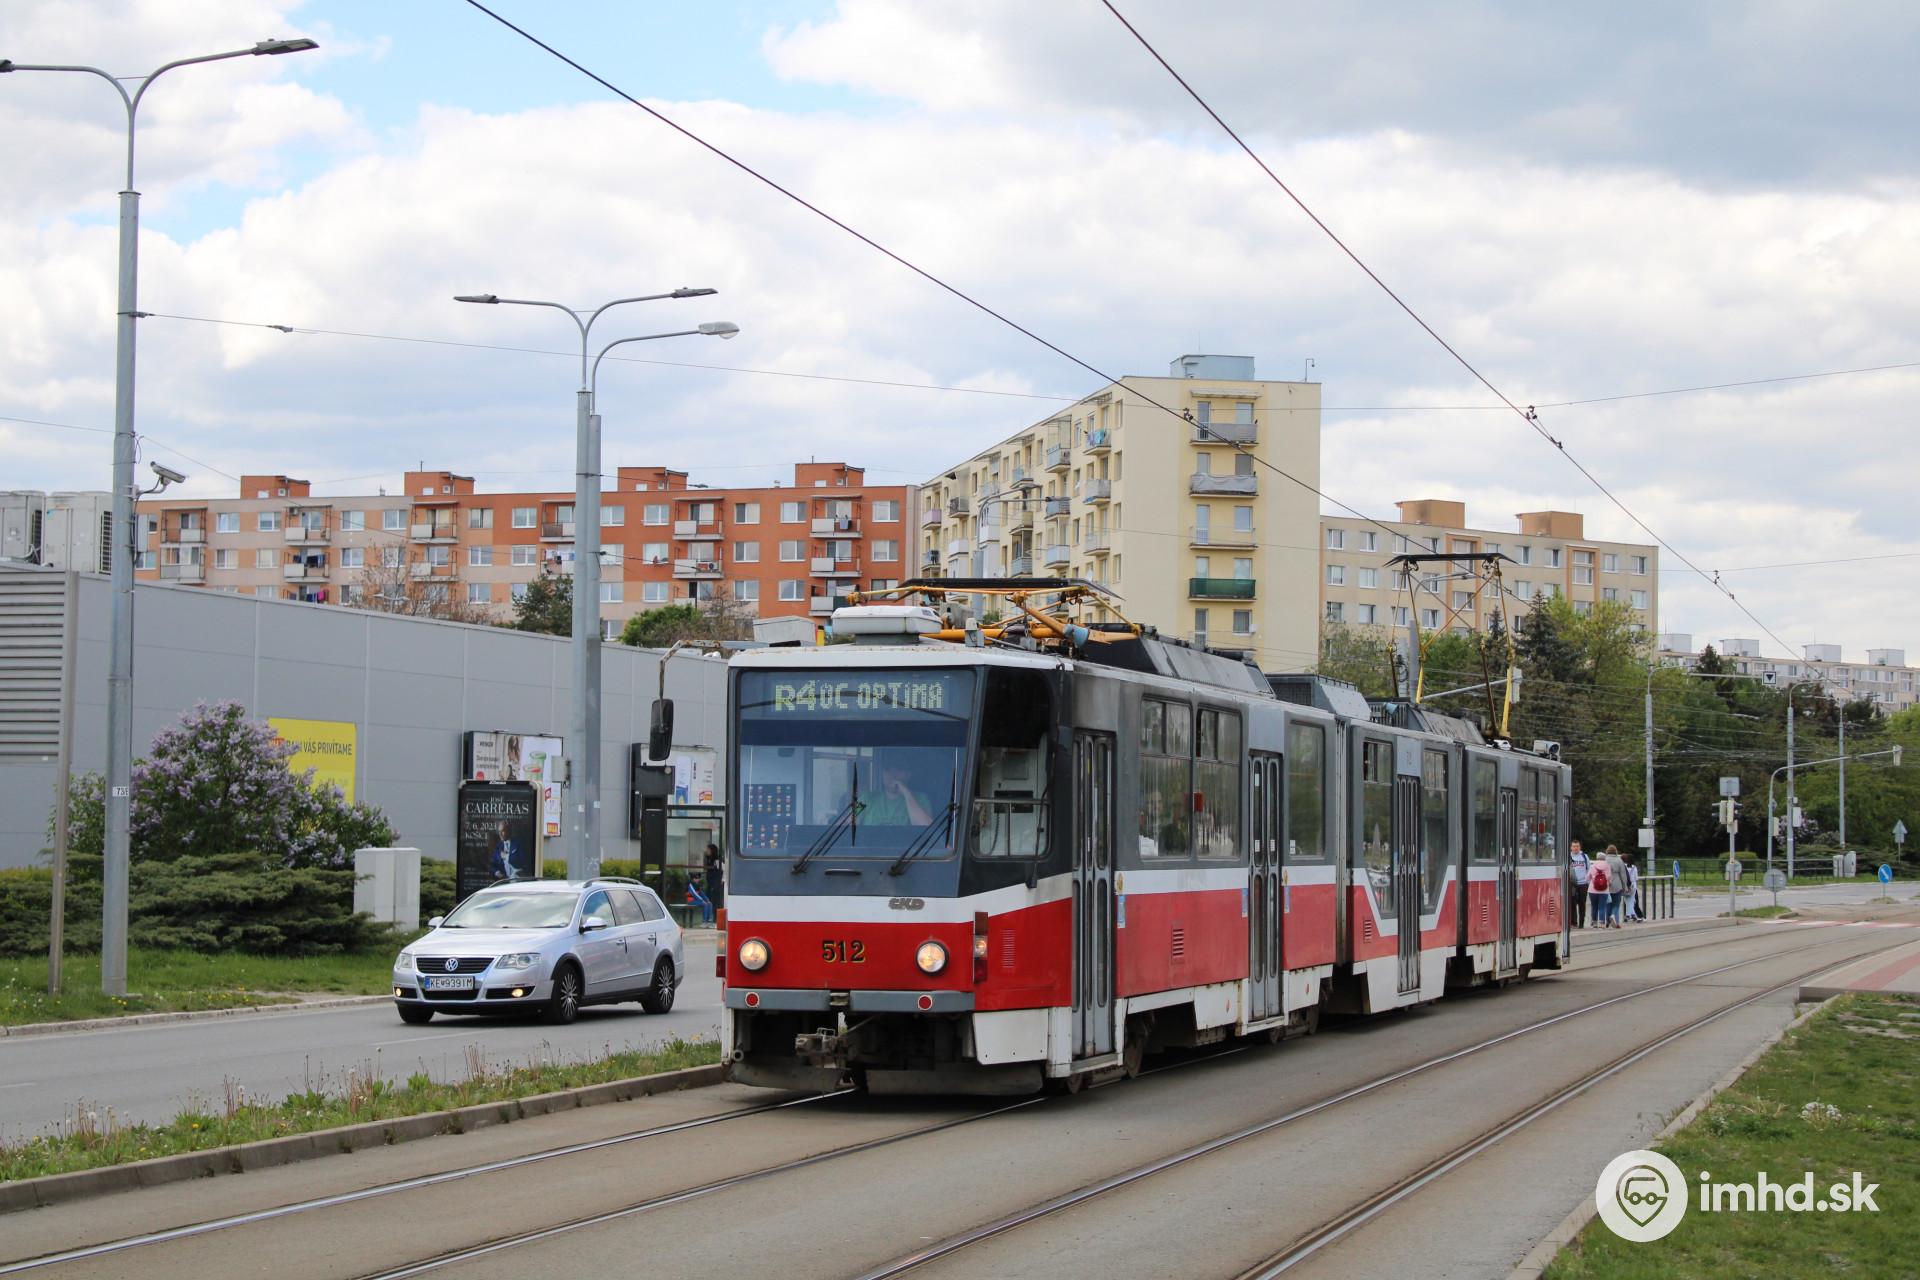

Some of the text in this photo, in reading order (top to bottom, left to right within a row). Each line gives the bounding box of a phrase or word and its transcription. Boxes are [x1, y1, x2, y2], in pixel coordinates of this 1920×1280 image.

[775, 680, 816, 711] R4
[857, 681, 943, 709] OPTIMA
[303, 737, 317, 754] VÁS
[318, 739, 353, 756] PRIVÍTAME
[465, 802, 529, 815] CARRERAS
[822, 939, 866, 963] 512
